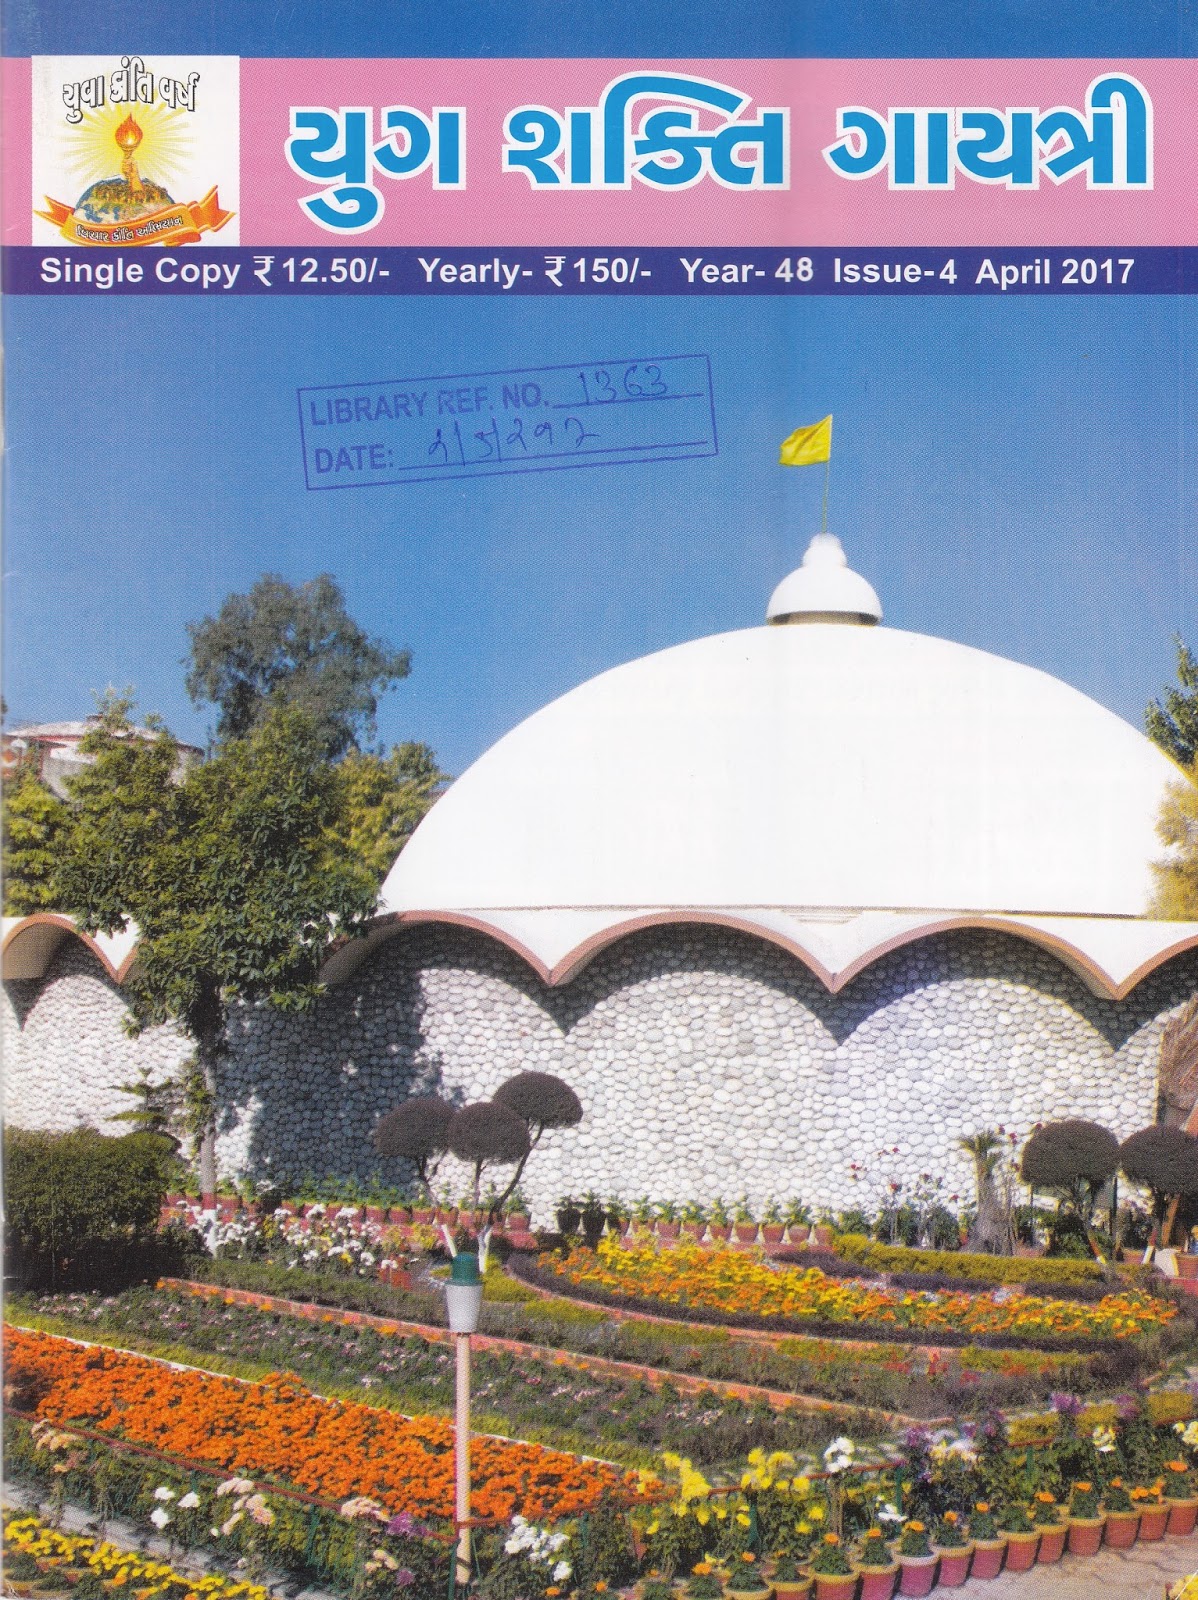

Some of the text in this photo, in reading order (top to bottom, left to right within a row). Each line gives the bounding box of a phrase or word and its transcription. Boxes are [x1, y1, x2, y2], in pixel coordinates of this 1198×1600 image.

[62, 75, 105, 124] યુવા
[158, 71, 201, 113] વર્ષ
[285, 71, 1154, 234] યુગ શક્તિ ગાયત્રી
[40, 257, 144, 289] Single
[155, 257, 241, 289] Copy
[417, 257, 533, 290] Yearly-
[679, 258, 766, 283] Year-
[774, 256, 814, 283] 48
[975, 258, 1050, 291] April
[1061, 258, 1135, 284] 2017
[310, 382, 549, 426] LIBRARY REF. NO.
[314, 443, 394, 474] DATE:
